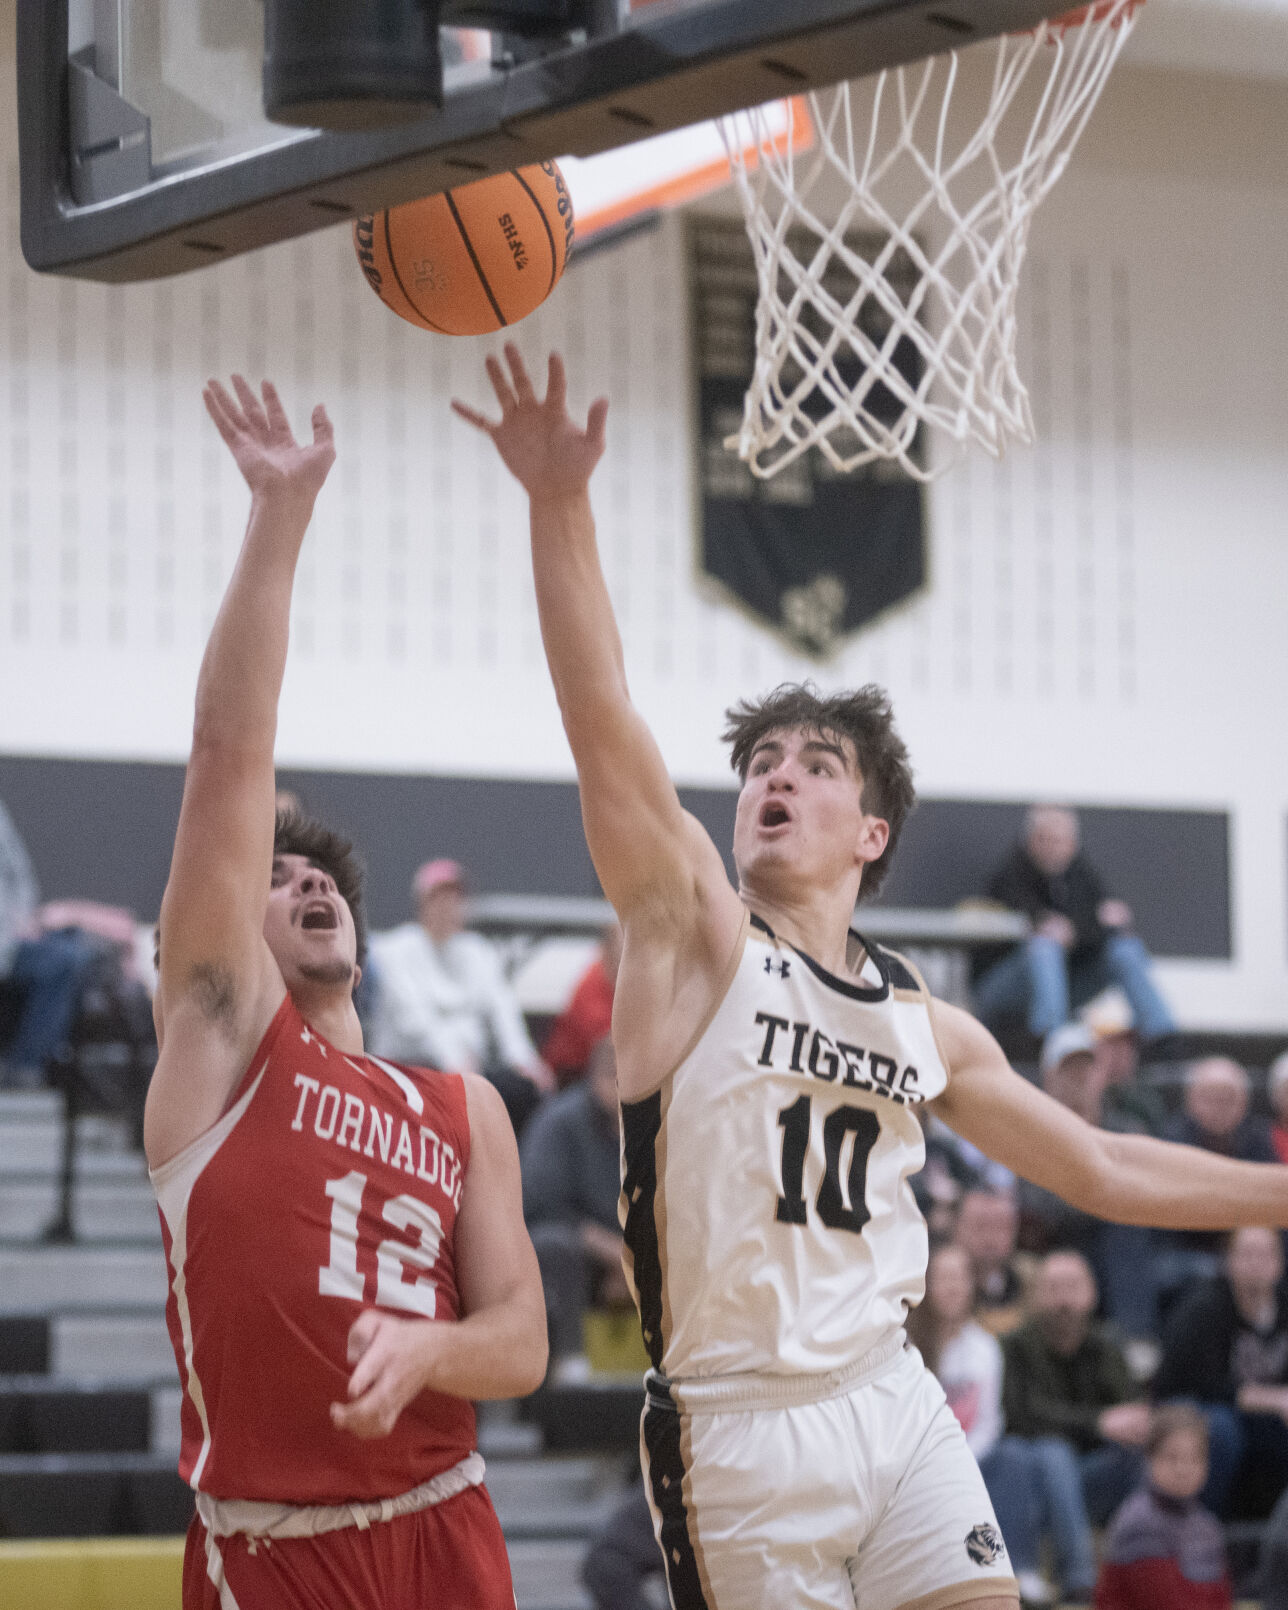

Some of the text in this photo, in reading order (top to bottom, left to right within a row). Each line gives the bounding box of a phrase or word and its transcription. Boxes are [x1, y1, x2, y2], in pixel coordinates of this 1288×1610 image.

[498, 213, 526, 261] NFHS
[754, 1011, 926, 1103] TIGERS
[775, 1095, 881, 1234] 10
[318, 1170, 445, 1320] 12
